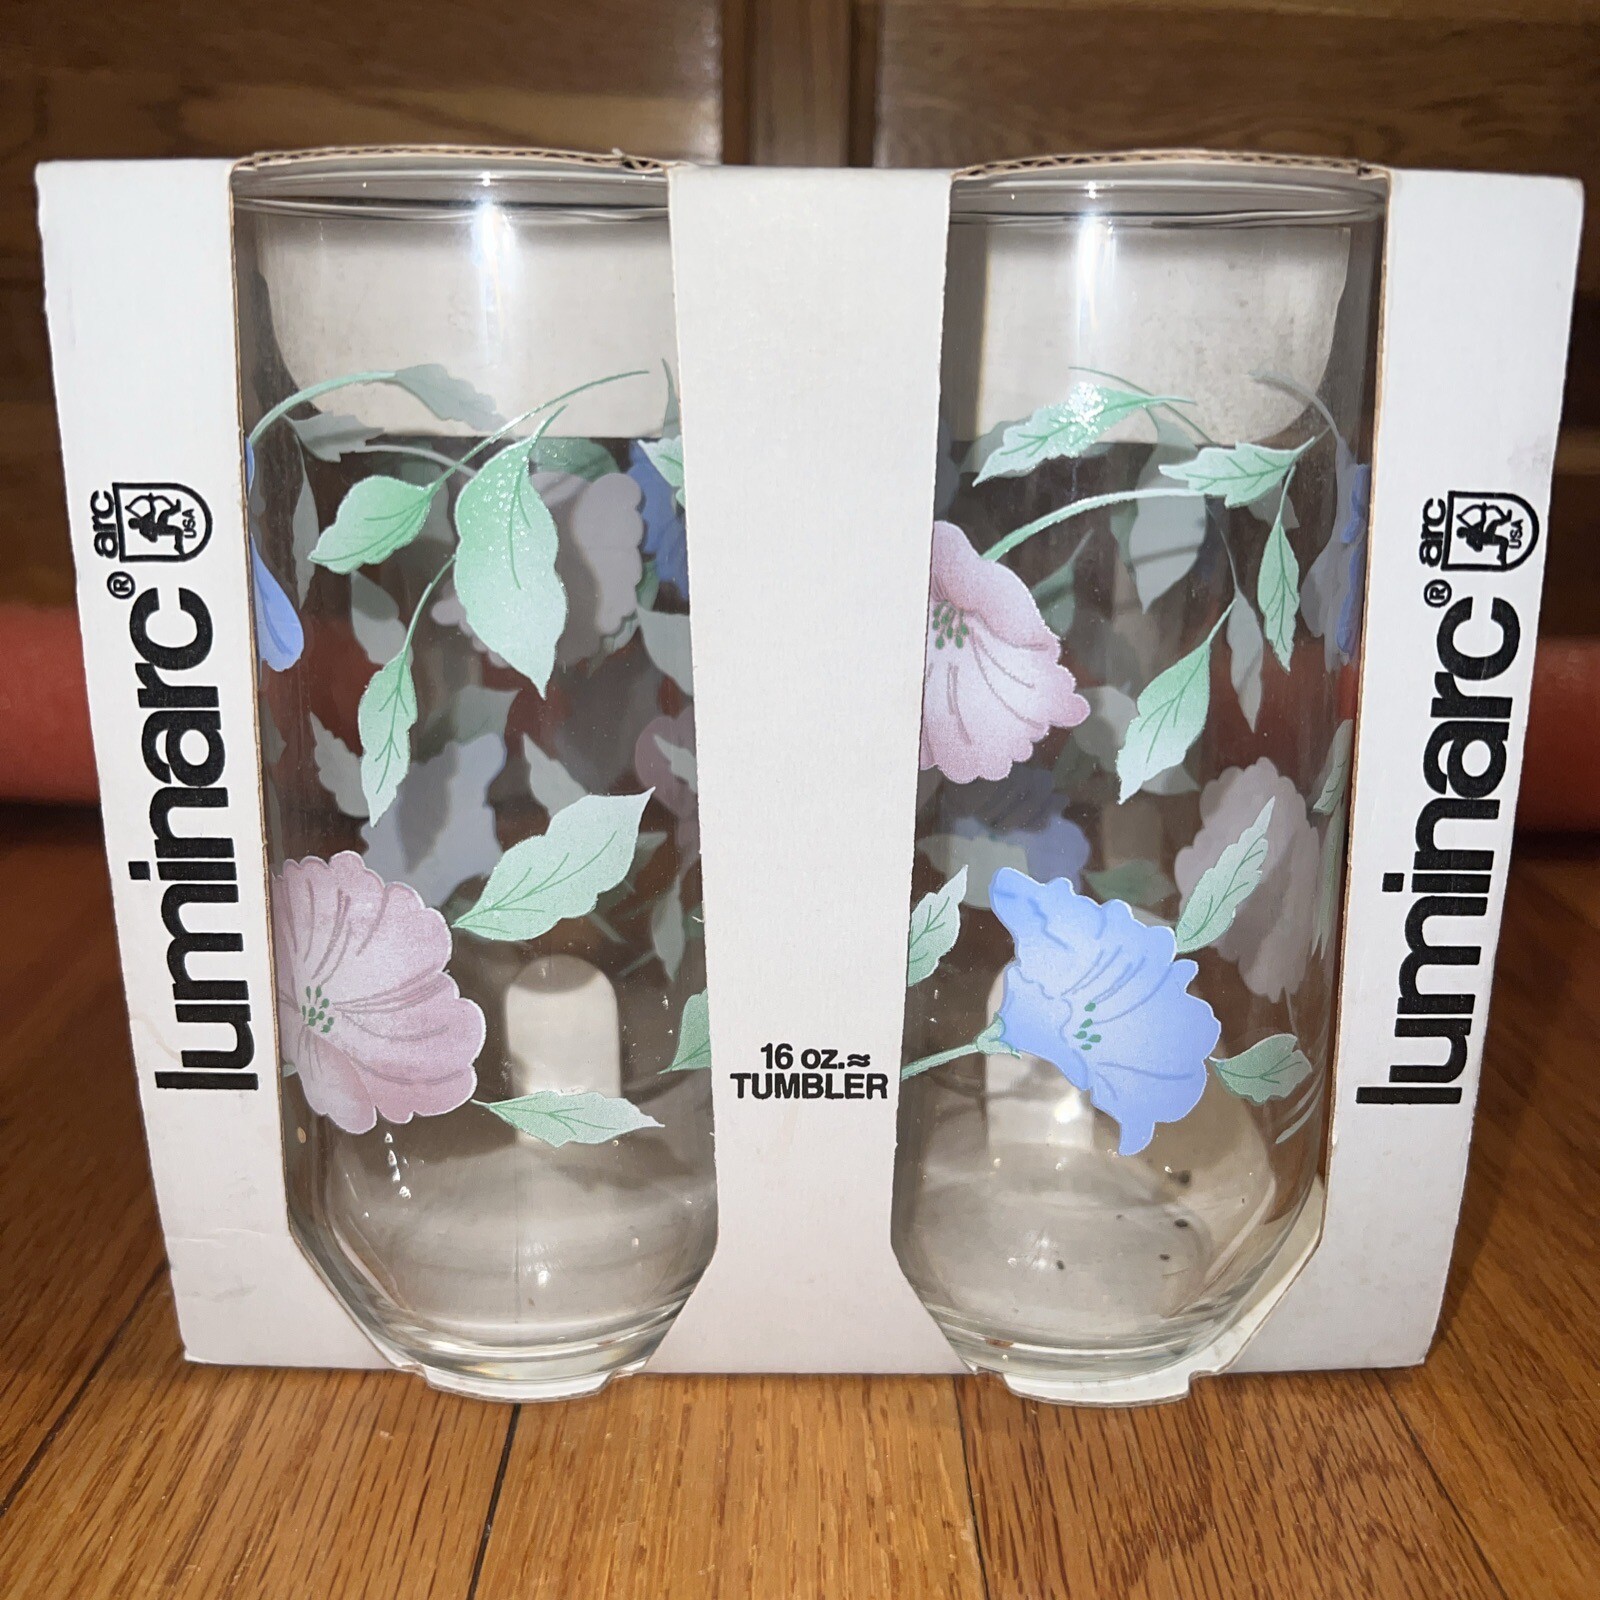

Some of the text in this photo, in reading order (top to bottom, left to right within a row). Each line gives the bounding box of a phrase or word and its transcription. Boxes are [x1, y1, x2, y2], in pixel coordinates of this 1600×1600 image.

[90, 490, 117, 558] arc
[181, 508, 197, 539] USA
[1419, 498, 1446, 567] arc
[1508, 519, 1523, 549] USA
[760, 1042, 794, 1070] 16
[729, 1072, 889, 1100] TUMBLER
